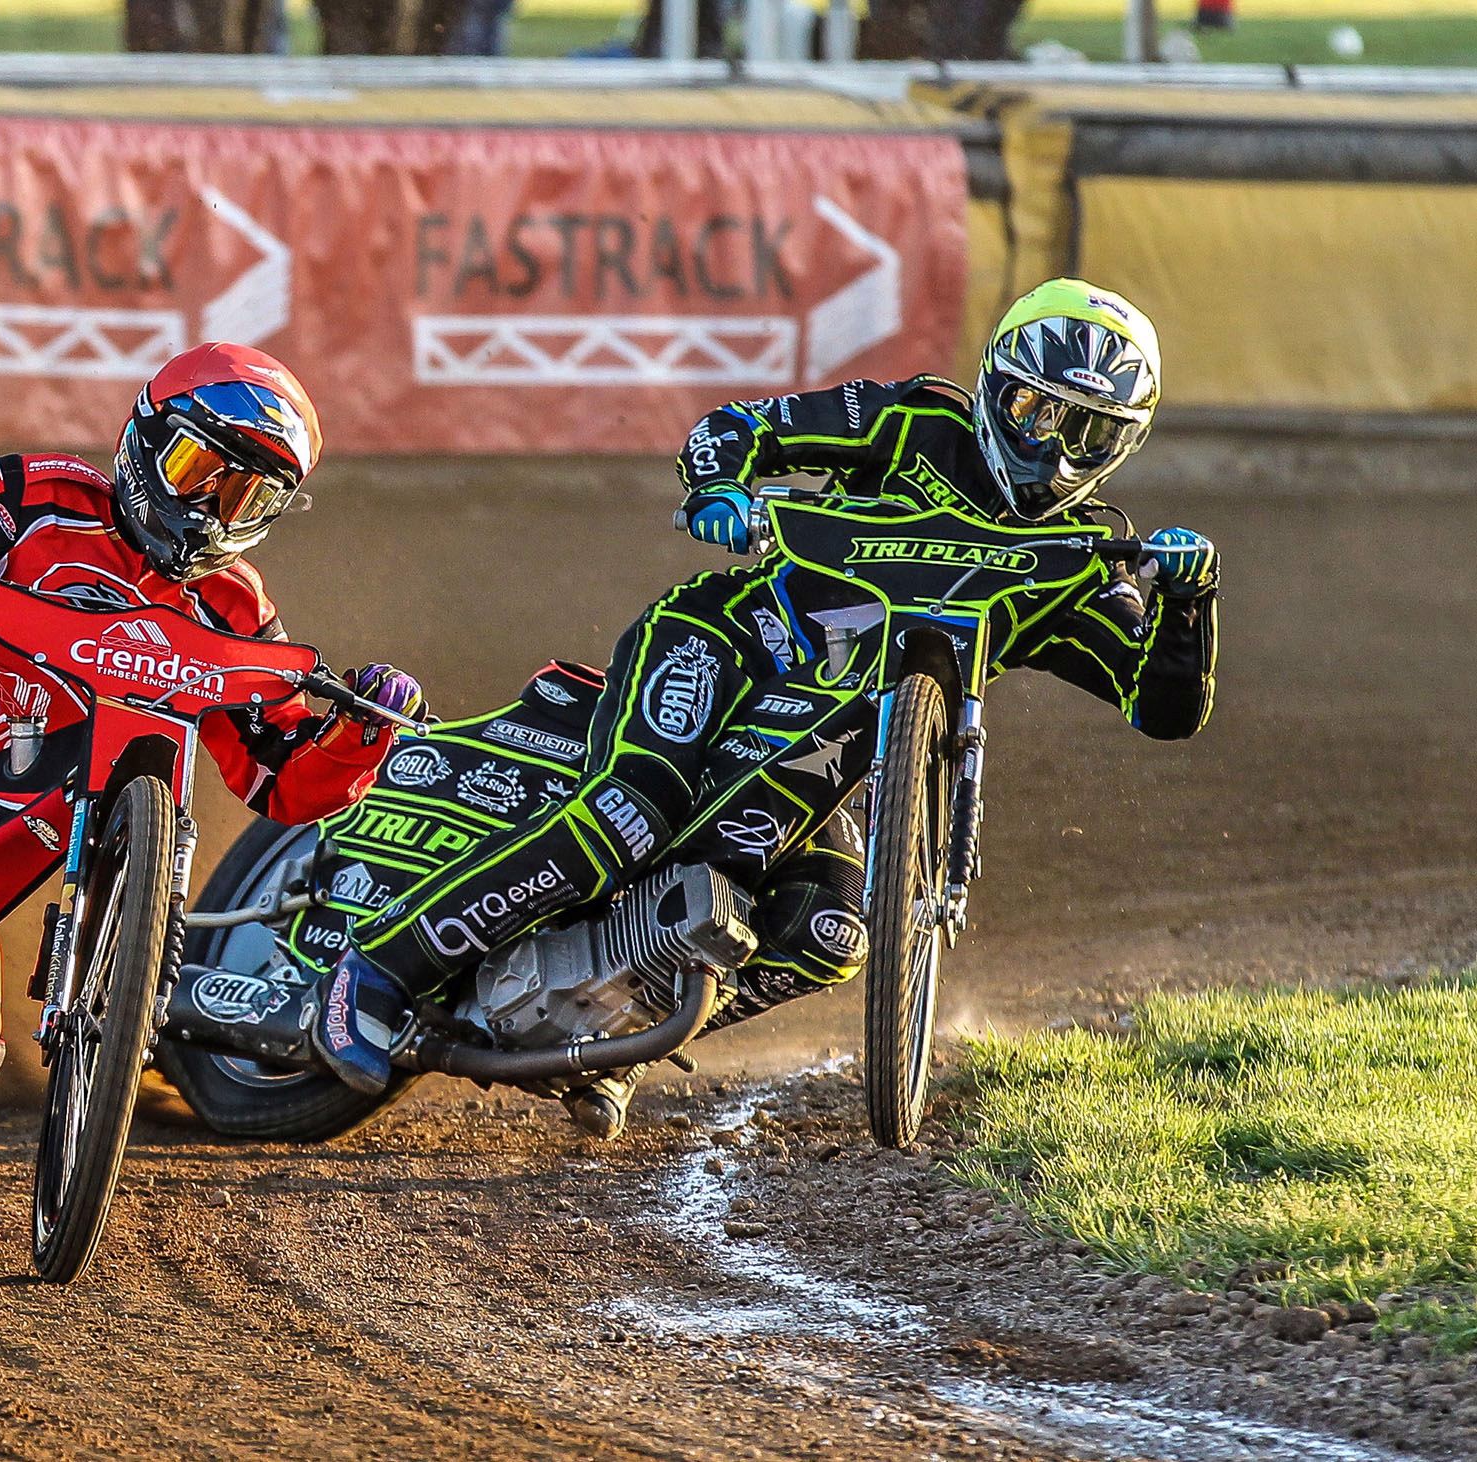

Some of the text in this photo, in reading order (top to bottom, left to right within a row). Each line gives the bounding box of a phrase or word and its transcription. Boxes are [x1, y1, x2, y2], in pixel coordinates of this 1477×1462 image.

[413, 212, 797, 300] FASTRACK
[1073, 371, 1107, 388] BELL
[861, 542, 1027, 569] TRU PLANT
[70, 639, 224, 694] Crendon
[96, 666, 223, 703] TIMBER ENGINERING
[659, 662, 701, 732] BALL
[497, 723, 586, 756] ONETWENTY
[485, 778, 512, 797] Stop
[358, 809, 431, 841] TRU
